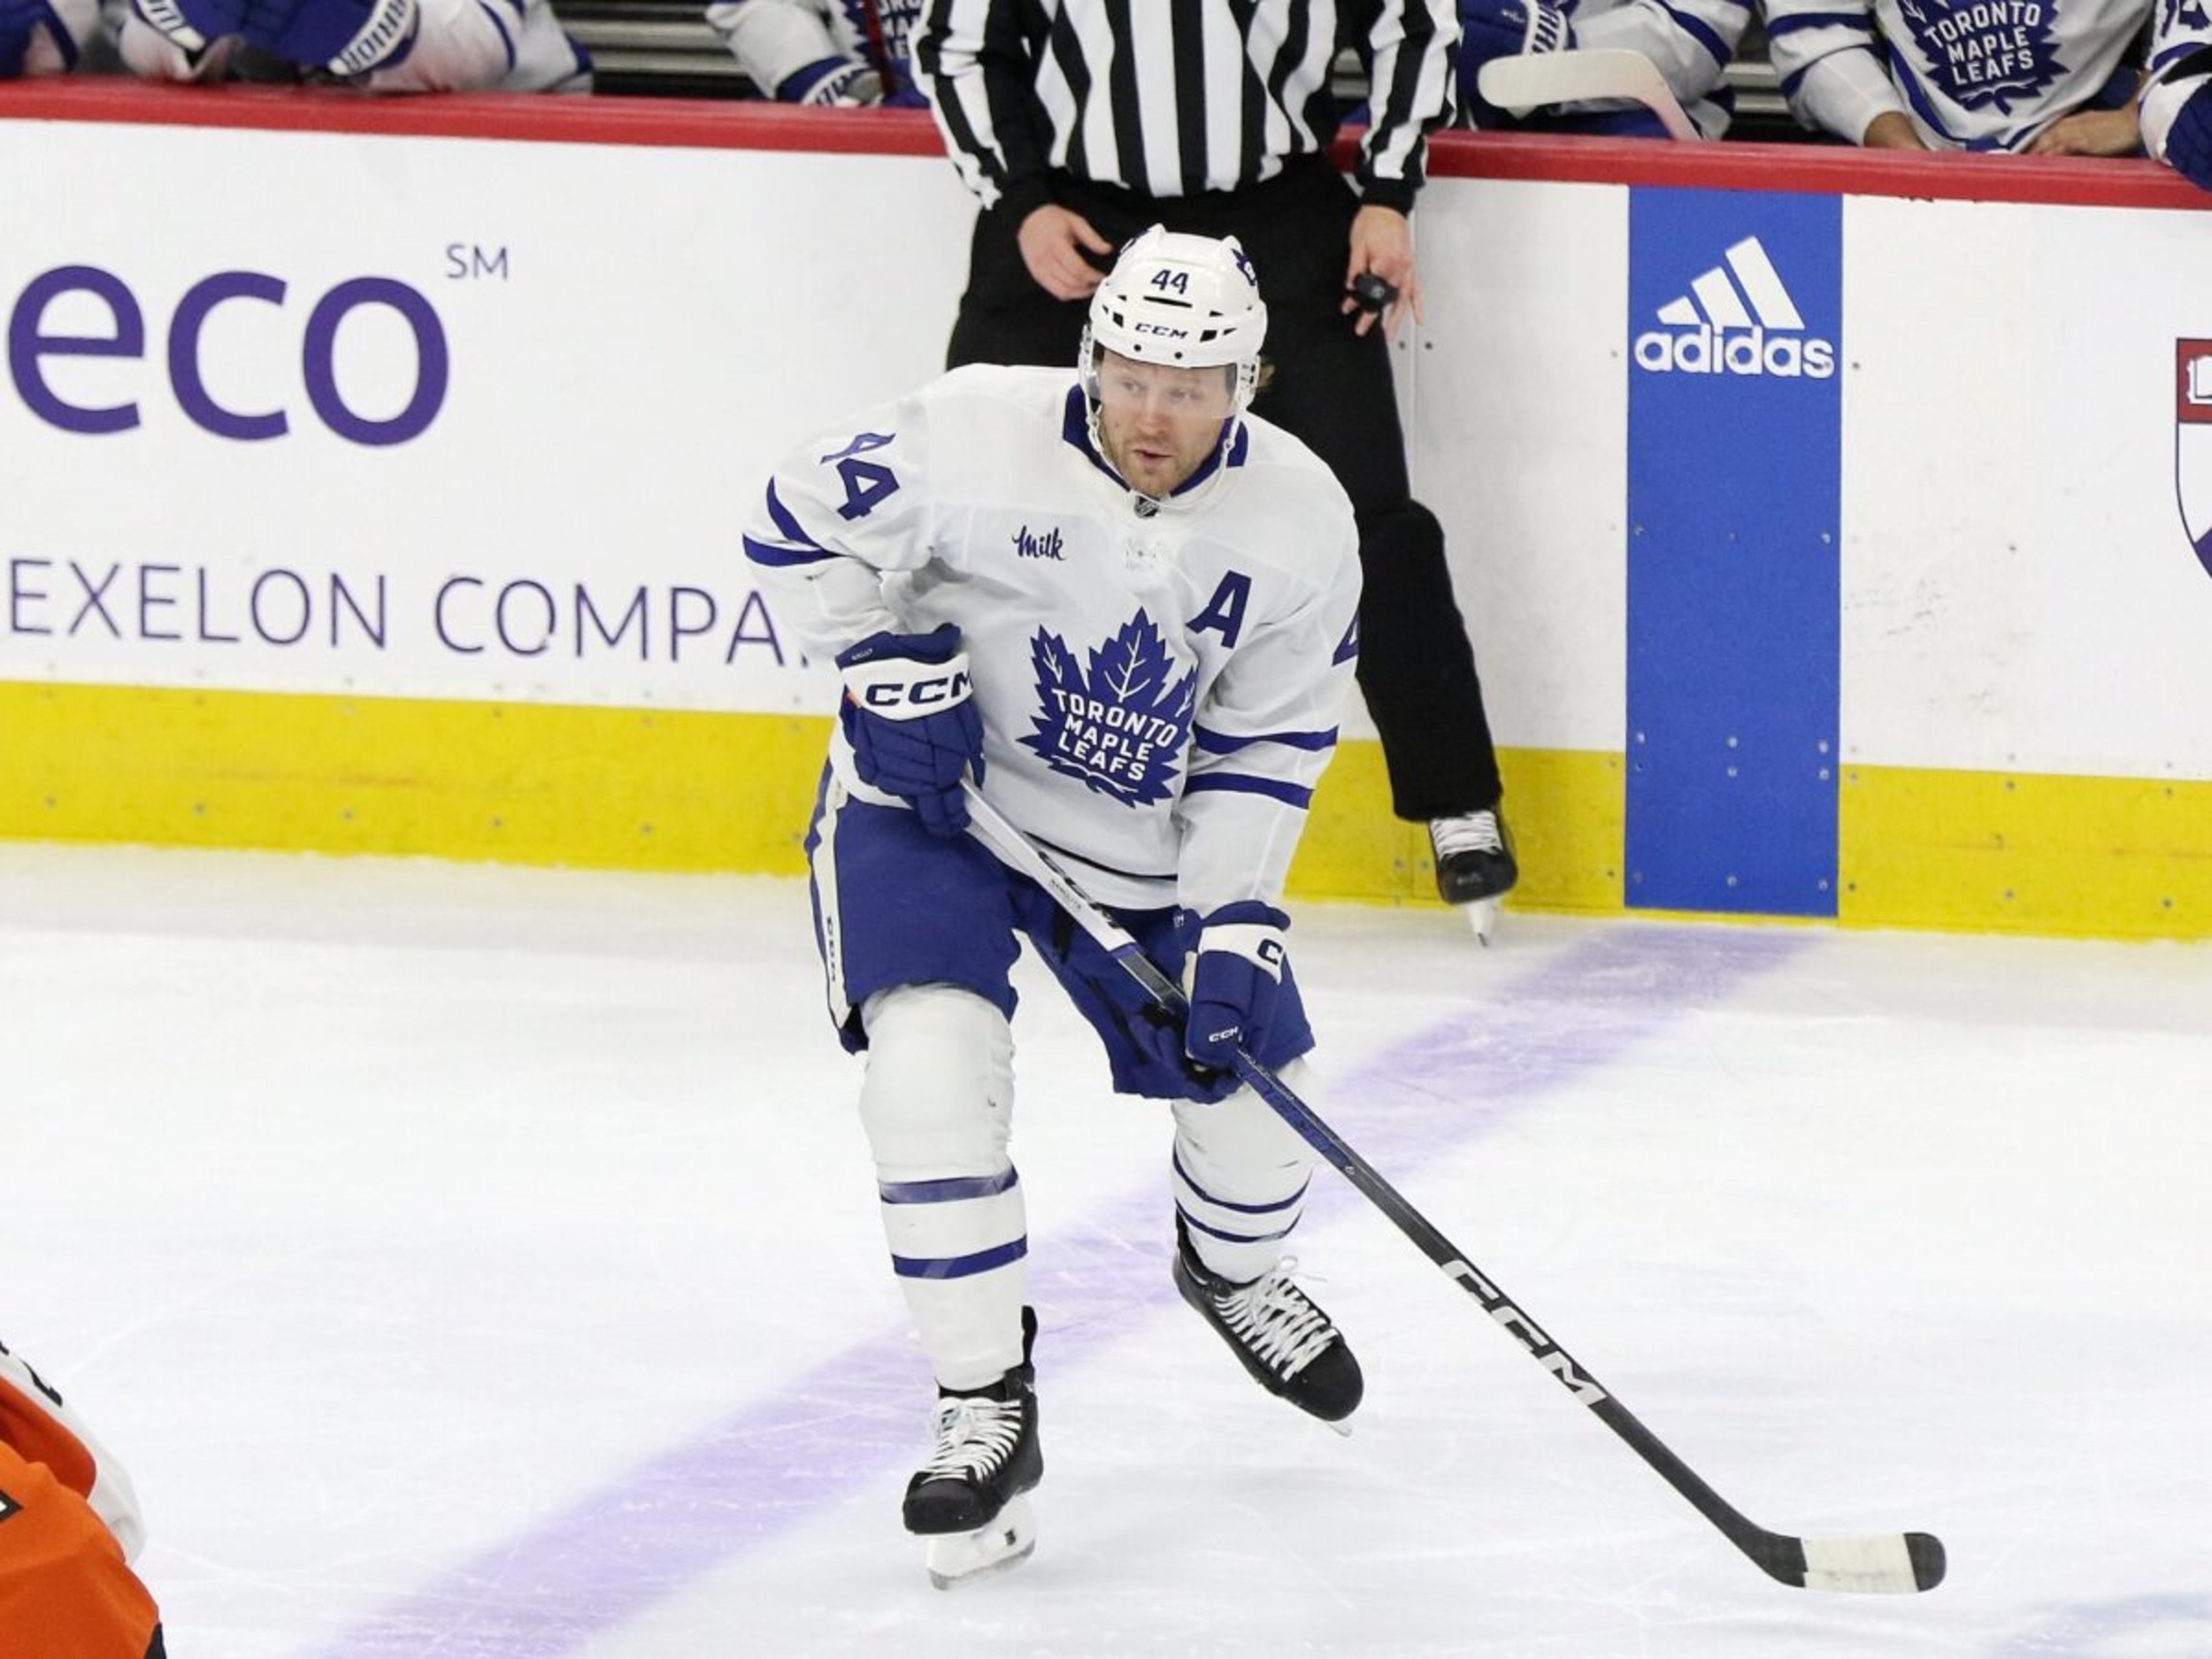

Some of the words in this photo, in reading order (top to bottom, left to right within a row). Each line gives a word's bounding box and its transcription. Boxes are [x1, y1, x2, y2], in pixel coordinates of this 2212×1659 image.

[1924, 2, 2040, 48] TORONTO
[1947, 26, 2029, 64] MAPLE
[1951, 49, 2033, 85] LEAFS
[1150, 268, 1189, 295] 44
[7, 263, 449, 447] eco
[445, 243, 508, 280] SM
[1135, 322, 1188, 339] CCM
[1634, 324, 1834, 378] adidas
[9, 557, 387, 650] EXELON
[434, 575, 809, 667] COMPA
[1186, 569, 1253, 649] A
[866, 671, 972, 706] CCM
[1051, 687, 1179, 748] TORONTO
[1064, 713, 1155, 762] MAPLE
[1057, 731, 1146, 781] LEAFS
[1209, 1025, 1239, 1042] CCM
[1440, 1260, 1608, 1406] CCM
